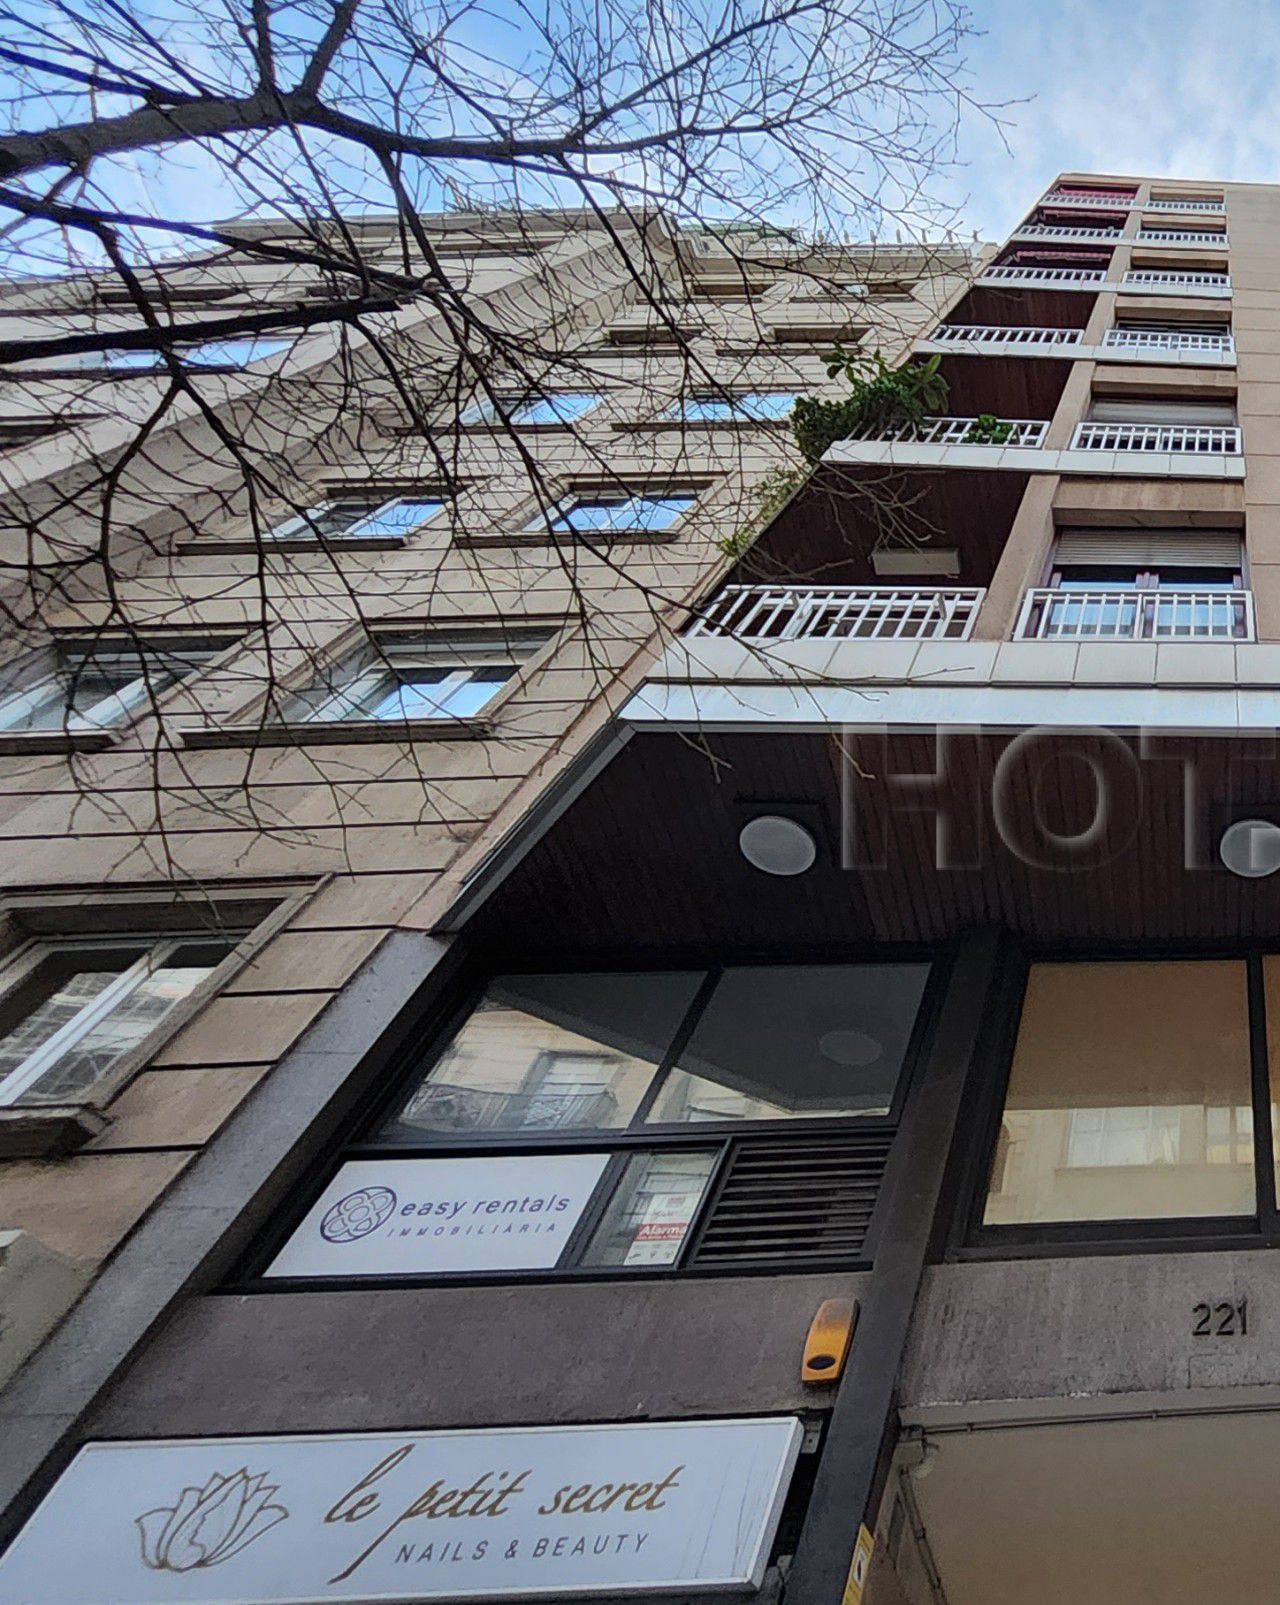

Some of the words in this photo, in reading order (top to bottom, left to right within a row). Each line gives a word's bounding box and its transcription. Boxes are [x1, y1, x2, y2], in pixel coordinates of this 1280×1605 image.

[399, 1201, 468, 1220] easy
[472, 1194, 571, 1214] rentals
[1192, 1298, 1248, 1336] 221
[324, 1443, 417, 1523] le
[538, 1465, 686, 1515] secret
[327, 1469, 533, 1585] petit
[394, 1540, 490, 1564] NAILS
[504, 1538, 518, 1559] &
[532, 1533, 650, 1558] BEAUTY
